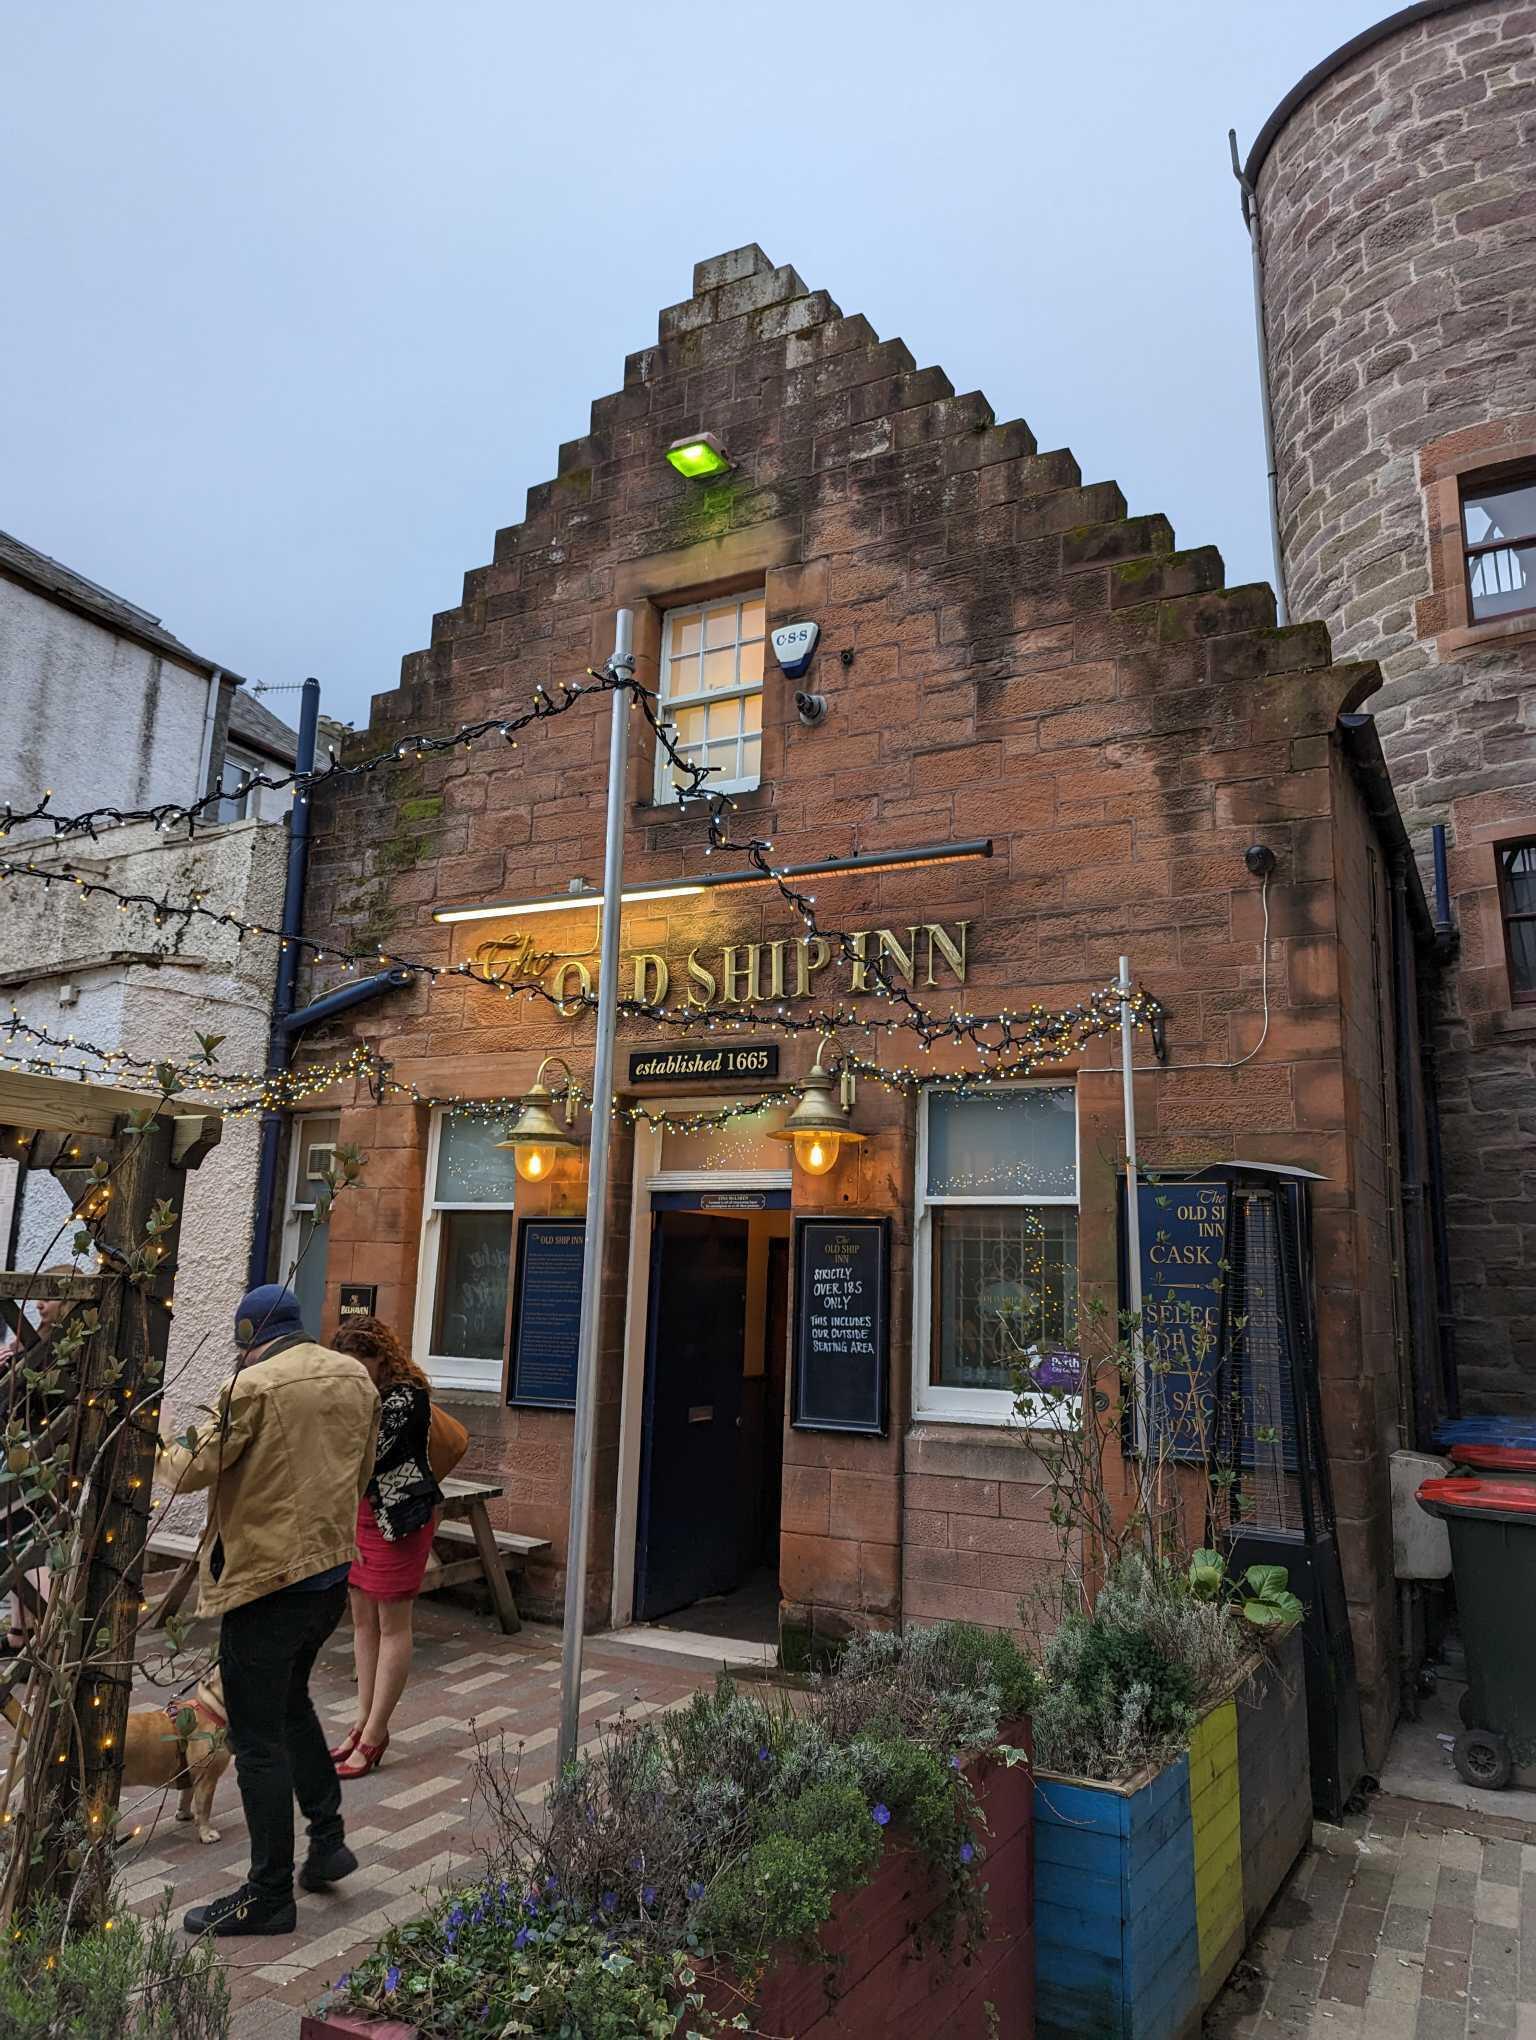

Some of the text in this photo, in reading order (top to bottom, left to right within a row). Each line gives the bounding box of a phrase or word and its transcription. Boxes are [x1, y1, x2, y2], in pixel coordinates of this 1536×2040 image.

[474, 931, 555, 981] The
[552, 920, 972, 1017] OD SHIP INN
[634, 1051, 768, 1075] established 1665
[1197, 1189, 1226, 1205] The
[1177, 1206, 1207, 1220] OLD
[1199, 1223, 1225, 1237] INN
[825, 1245, 860, 1254] OLD SHIP
[1149, 1245, 1213, 1265] CASK
[835, 1254, 849, 1264] INN
[814, 1267, 852, 1281] STRICTLY
[814, 1283, 841, 1296] OVER
[341, 1305, 369, 1315] BELHAVEN
[823, 1296, 851, 1310] ONLY
[810, 1314, 871, 1327] THIS INCLUDES
[812, 1329, 868, 1339] OUR OUTSIDE
[813, 1340, 874, 1354] SEATING AREA
